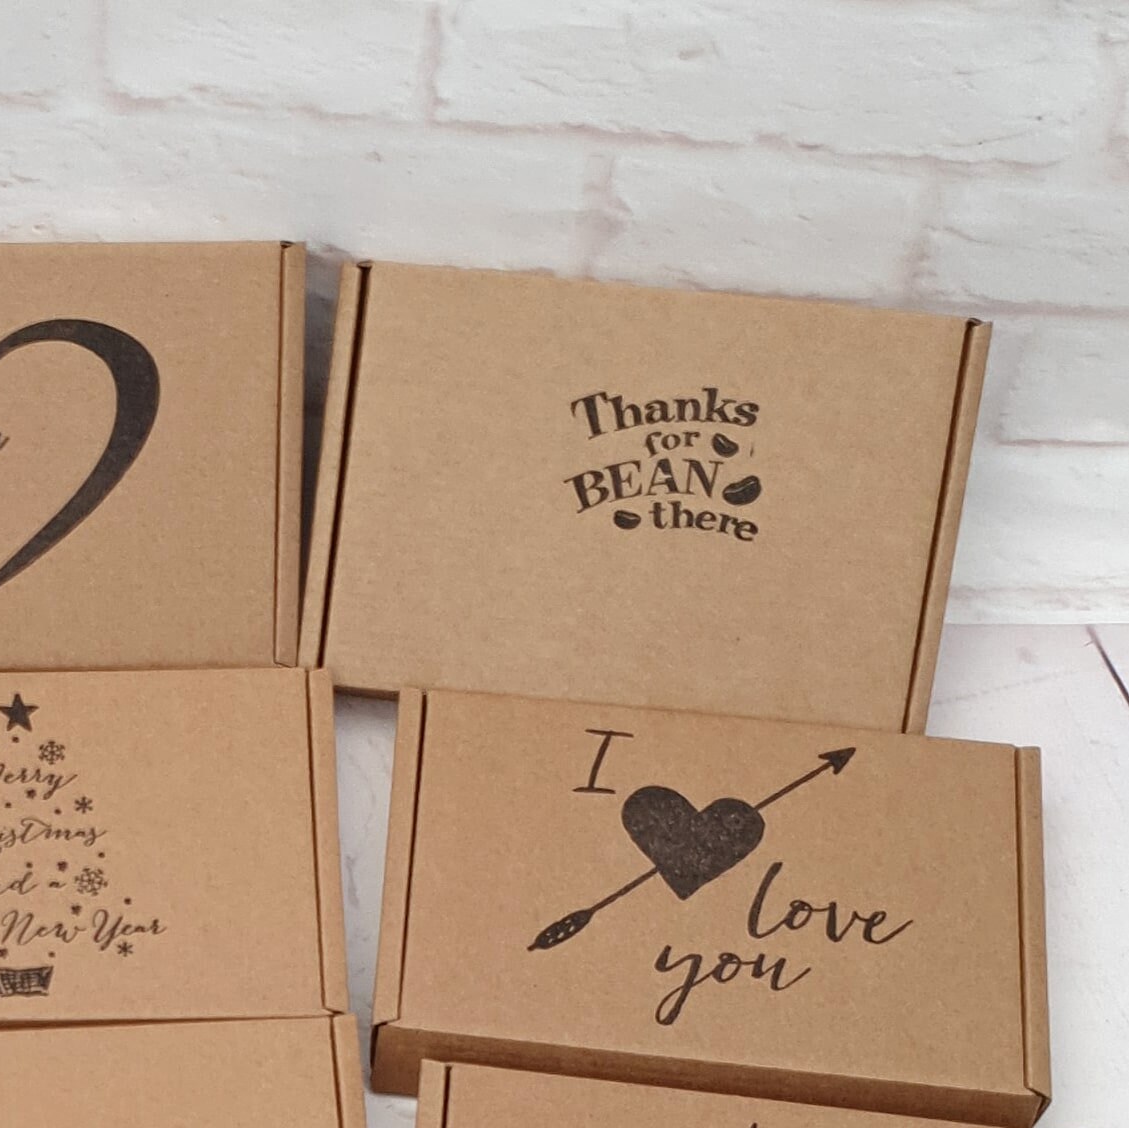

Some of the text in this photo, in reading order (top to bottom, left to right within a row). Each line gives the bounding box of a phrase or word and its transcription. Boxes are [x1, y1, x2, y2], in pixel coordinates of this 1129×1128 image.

[570, 387, 760, 440] Thanks
[645, 431, 701, 458] for
[563, 457, 725, 514] BEAN
[649, 501, 759, 542] there
[572, 729, 634, 795] I
[48, 879, 67, 890] a
[747, 862, 914, 945] love
[1, 909, 87, 946] New
[92, 908, 167, 952] Year
[654, 944, 812, 1027] you
